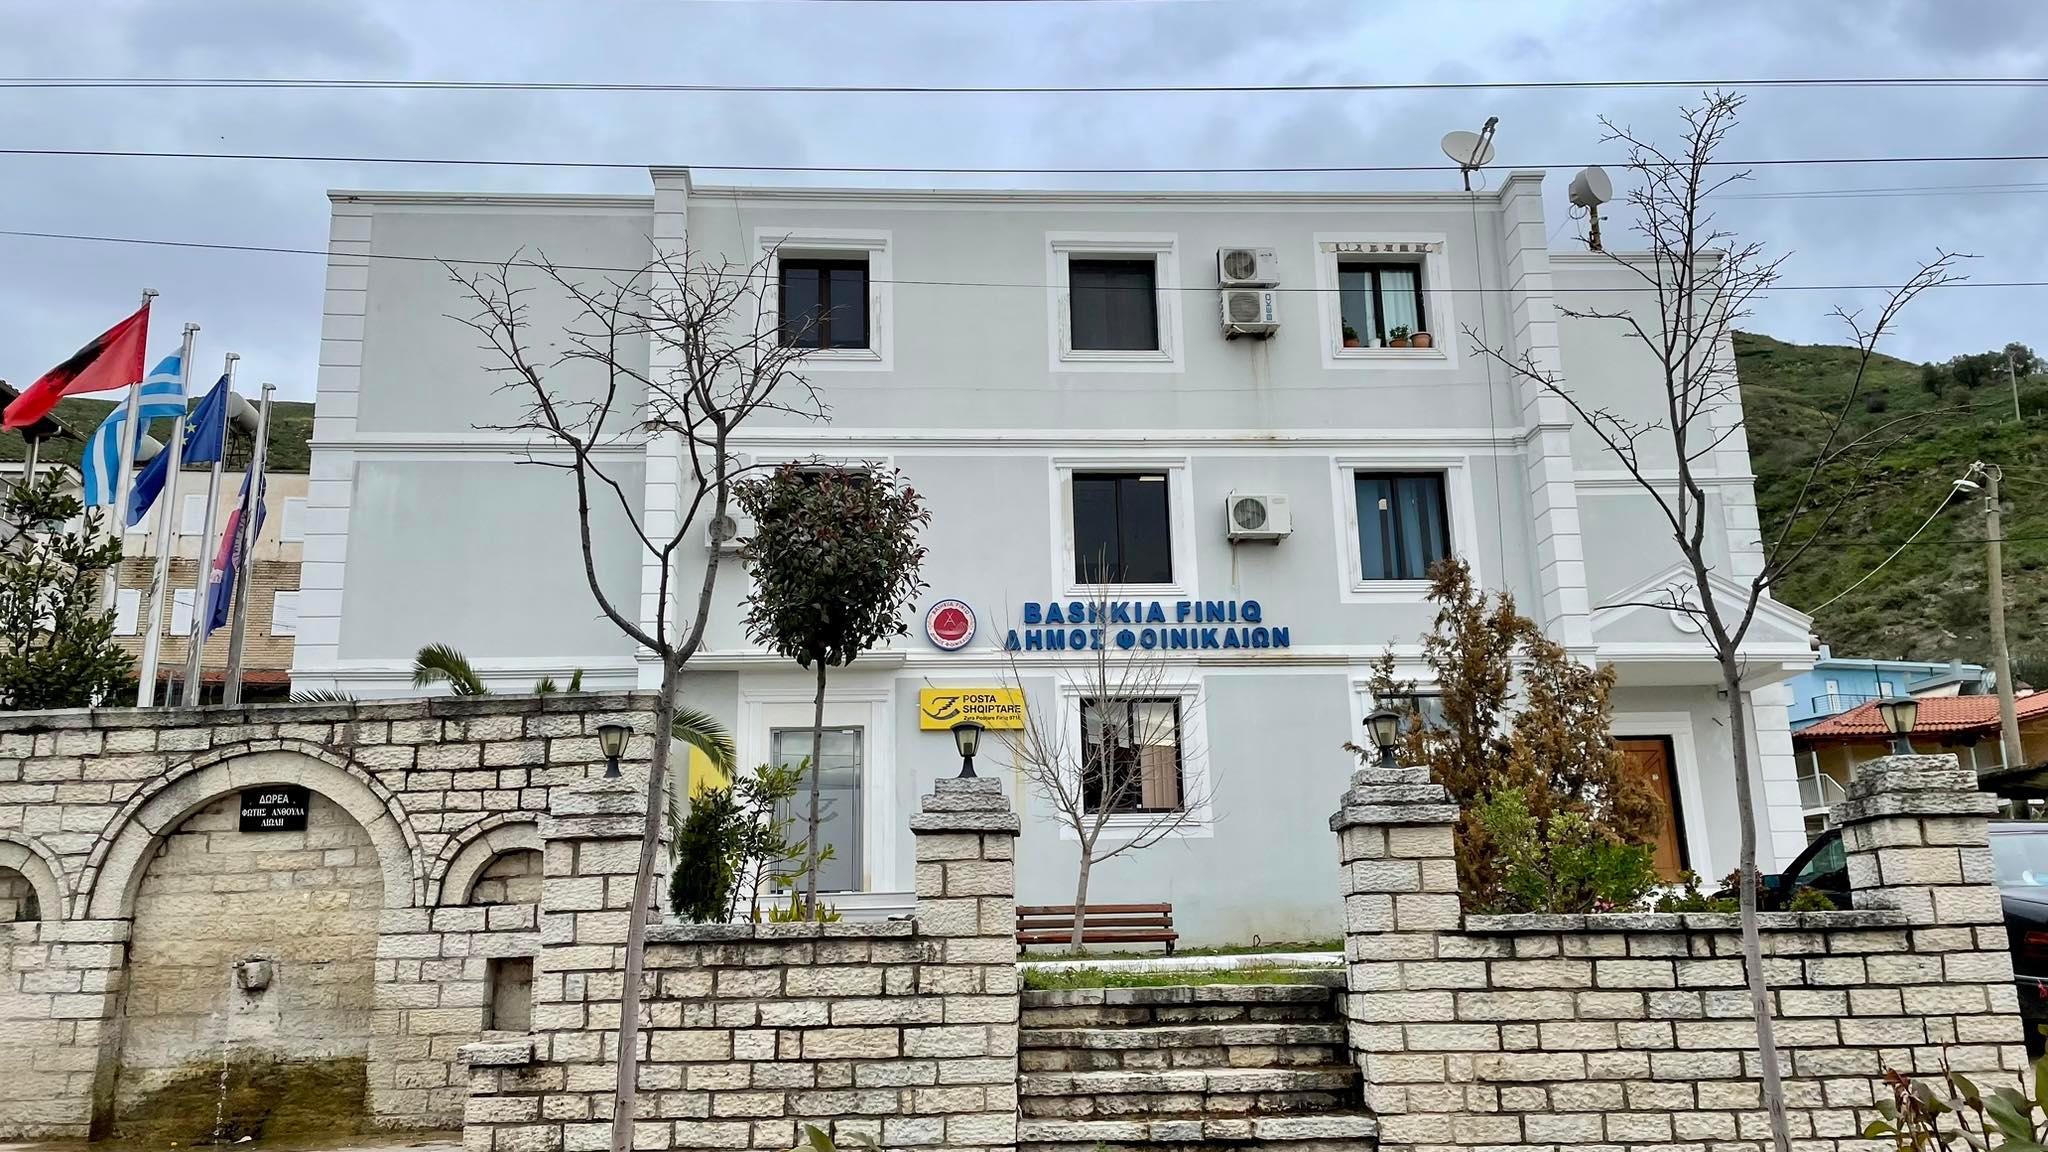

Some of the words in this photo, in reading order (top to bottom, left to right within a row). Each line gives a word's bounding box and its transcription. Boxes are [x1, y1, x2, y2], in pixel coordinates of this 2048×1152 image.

[1024, 601, 1166, 624] BASHKIA
[1176, 600, 1262, 623] FINIQ
[1116, 627, 1291, 650] ΦΟΙΝΙΚΑΙΩΝ
[962, 694, 997, 703] POSTA
[962, 704, 1021, 714] SHQIPTARE
[259, 794, 289, 804] ΔΩΡΕΑ
